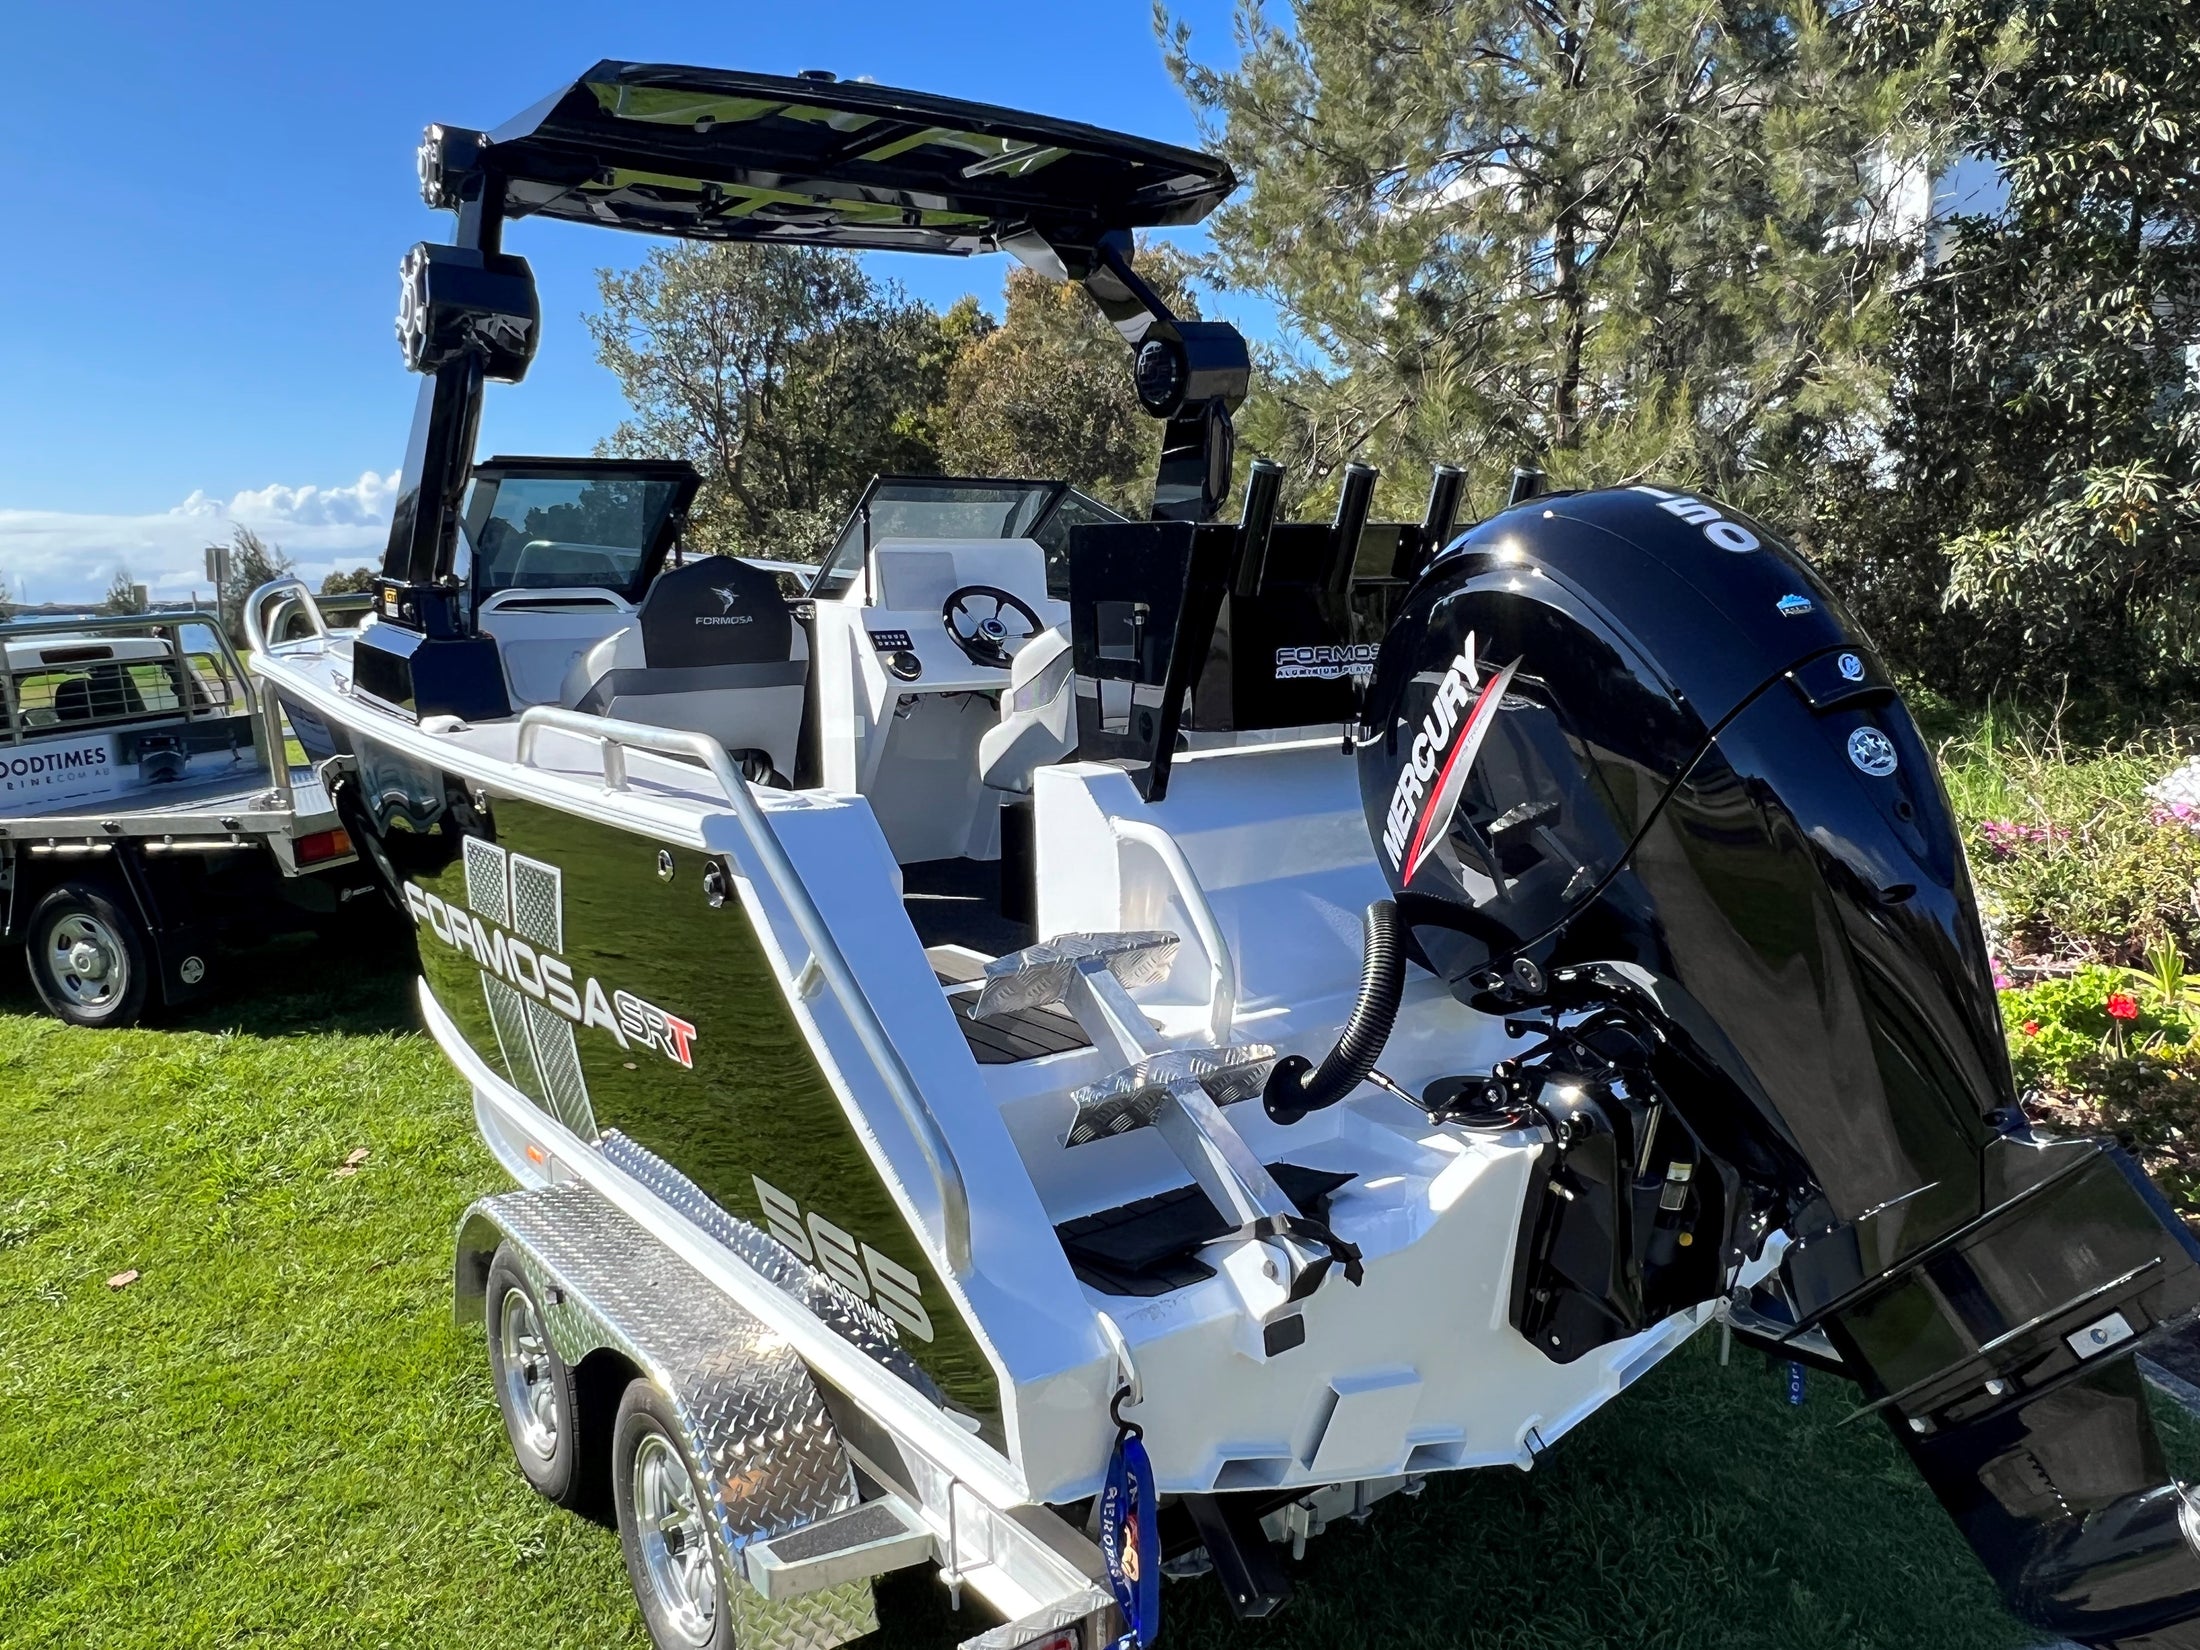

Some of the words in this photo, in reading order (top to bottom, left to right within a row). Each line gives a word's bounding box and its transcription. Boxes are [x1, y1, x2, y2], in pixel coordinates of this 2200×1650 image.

[1626, 485, 1760, 552] 150
[696, 616, 753, 624] FORMOSA
[1383, 630, 1479, 872] MERCURY
[403, 880, 630, 1050] FORMOSA
[613, 989, 697, 1070] SRT
[752, 1173, 935, 1344] 565
